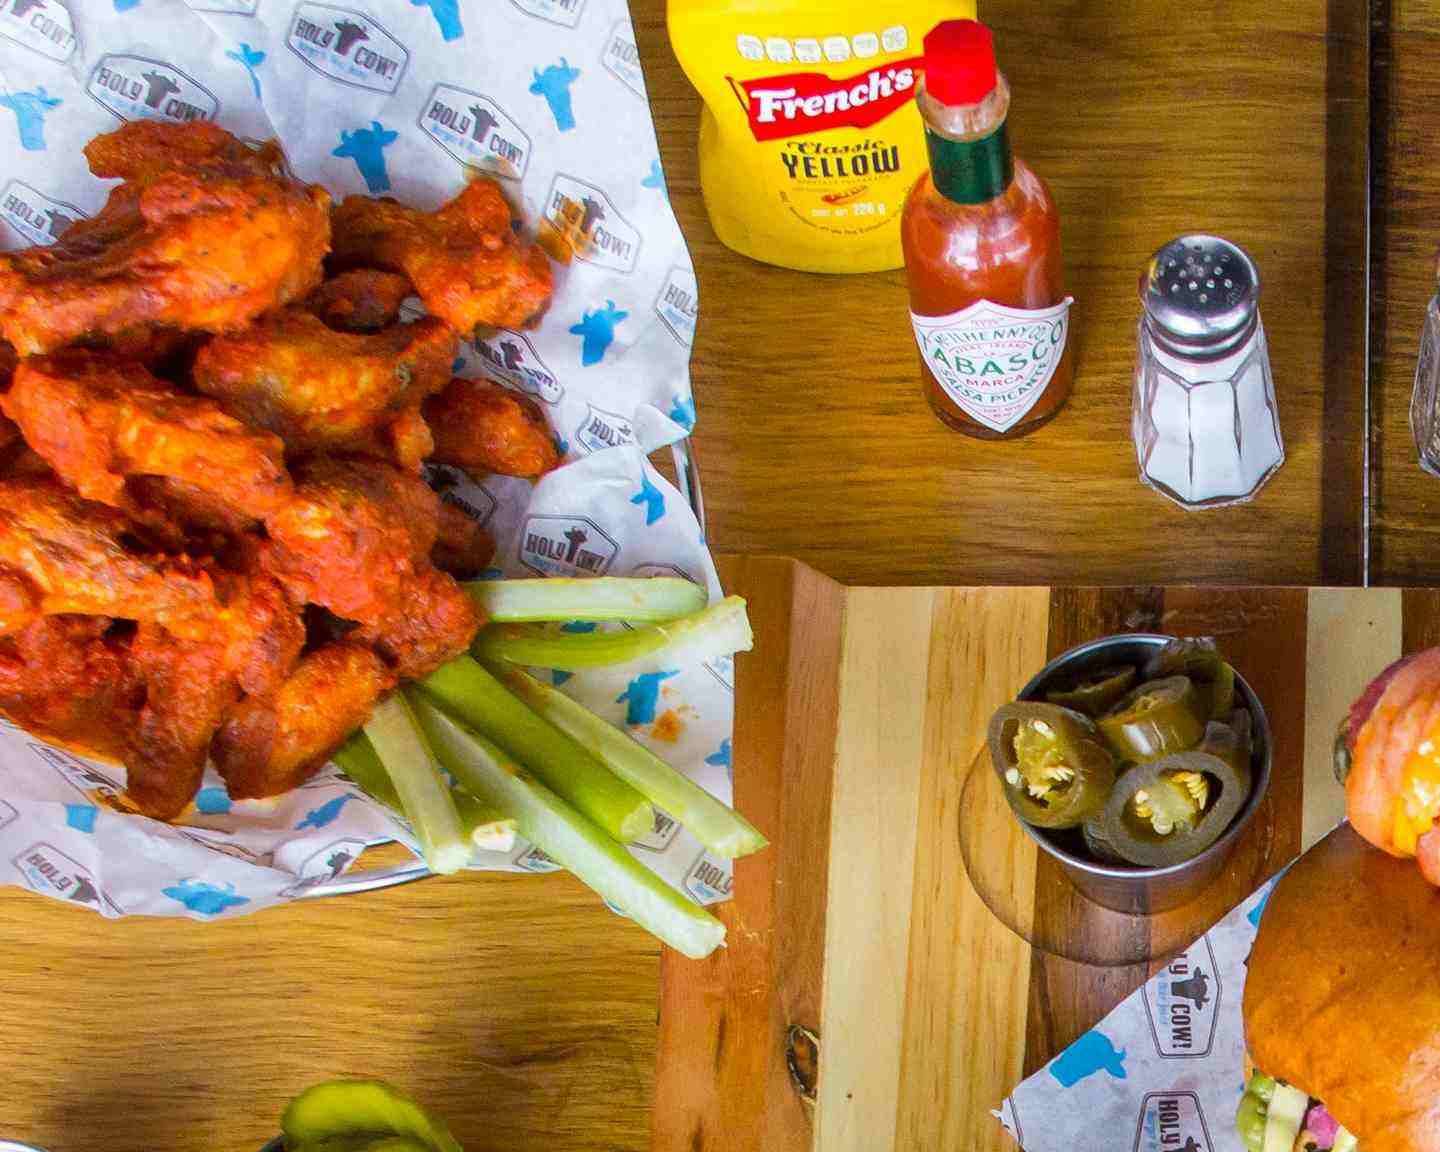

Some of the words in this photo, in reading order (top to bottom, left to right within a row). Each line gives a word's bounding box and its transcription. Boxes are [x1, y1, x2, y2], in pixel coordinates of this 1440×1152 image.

[295, 17, 335, 49] HOLY
[353, 47, 399, 80] COW!
[97, 66, 144, 100] HOLY
[749, 67, 915, 123] French's
[428, 100, 470, 134] HOLY
[489, 133, 524, 167] COW!
[786, 139, 884, 155] Classic
[780, 145, 900, 179] YELLOW
[592, 226, 632, 260] COW!
[965, 374, 1025, 389] MARCA
[526, 533, 566, 560] HOLY
[26, 853, 73, 891] HOLY
[1171, 1003, 1192, 1049] COW!
[1158, 1099, 1181, 1145] HOLY
